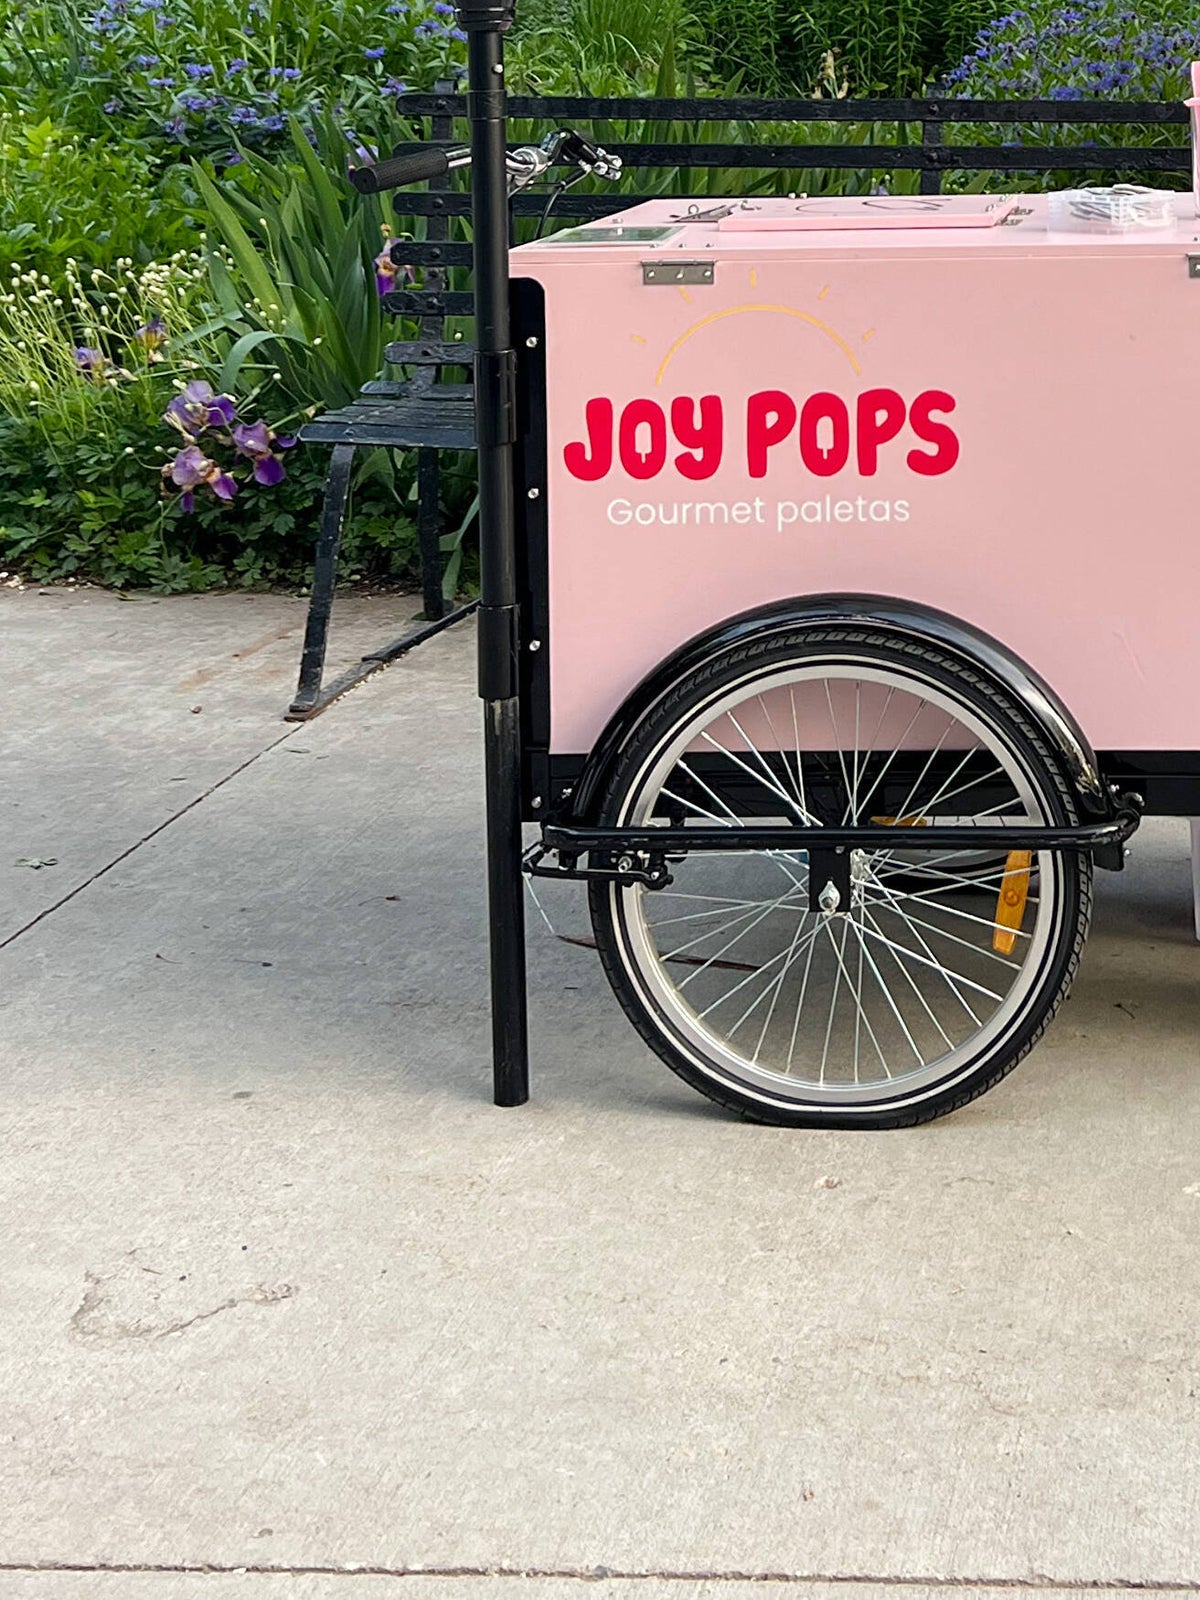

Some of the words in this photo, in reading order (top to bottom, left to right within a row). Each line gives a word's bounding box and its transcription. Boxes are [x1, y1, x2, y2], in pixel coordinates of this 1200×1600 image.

[563, 395, 723, 482] JOY
[747, 388, 960, 479] POPS
[606, 497, 766, 527] Gourmet
[777, 495, 911, 532] paletas
